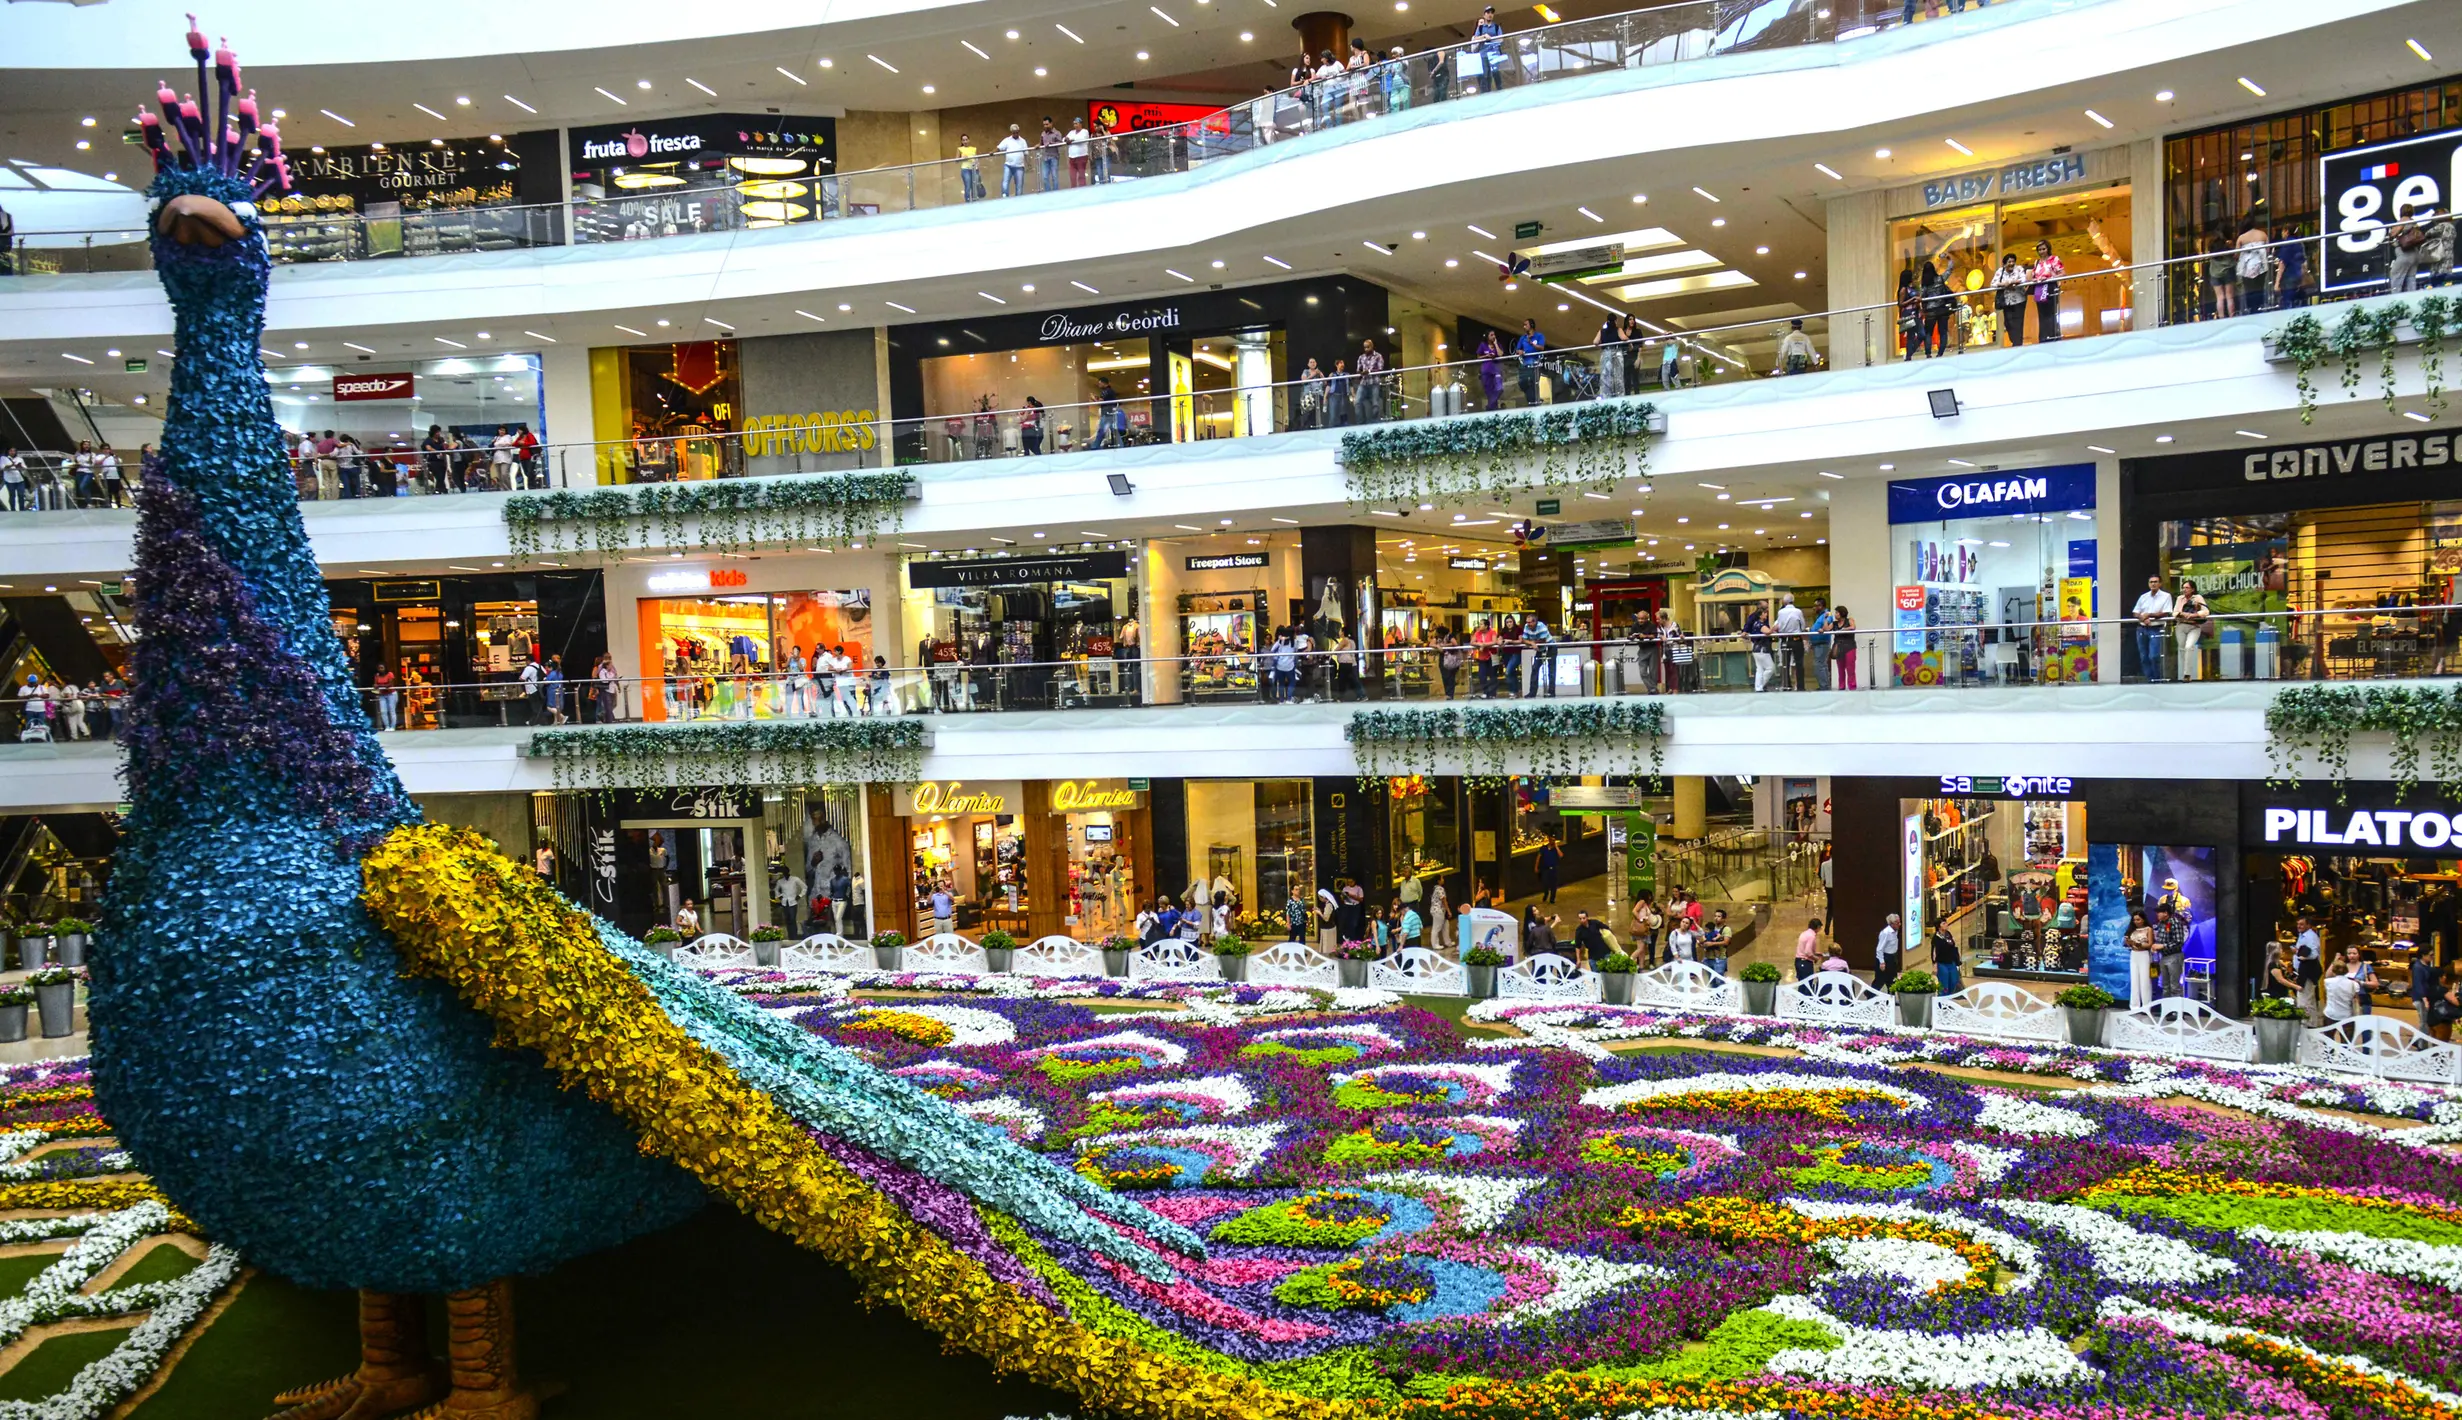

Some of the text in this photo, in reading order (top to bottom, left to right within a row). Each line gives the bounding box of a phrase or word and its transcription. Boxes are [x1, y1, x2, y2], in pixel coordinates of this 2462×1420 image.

[582, 135, 701, 159] fruta fresca
[291, 150, 457, 177] AMBIENTE
[379, 173, 457, 189] GOURMET
[1923, 154, 2087, 208] BABY FRESH
[644, 202, 702, 226] SALE
[1039, 308, 1181, 341] Diane & Geordi
[336, 379, 388, 396] speedo
[742, 409, 877, 457] OFFCORSS
[1963, 477, 2047, 504] LAFAM
[1191, 555, 1263, 569] Freeport Store
[709, 569, 748, 588] kids
[957, 565, 1074, 582] VILLA ROMANA
[2228, 571, 2265, 590] CHUCK
[1088, 640, 1112, 652] -45%
[2357, 639, 2417, 653] EL PRINCIPIO
[912, 781, 1005, 814] Leonisa
[1053, 779, 1138, 811] Leonisa
[693, 799, 741, 818] Stik
